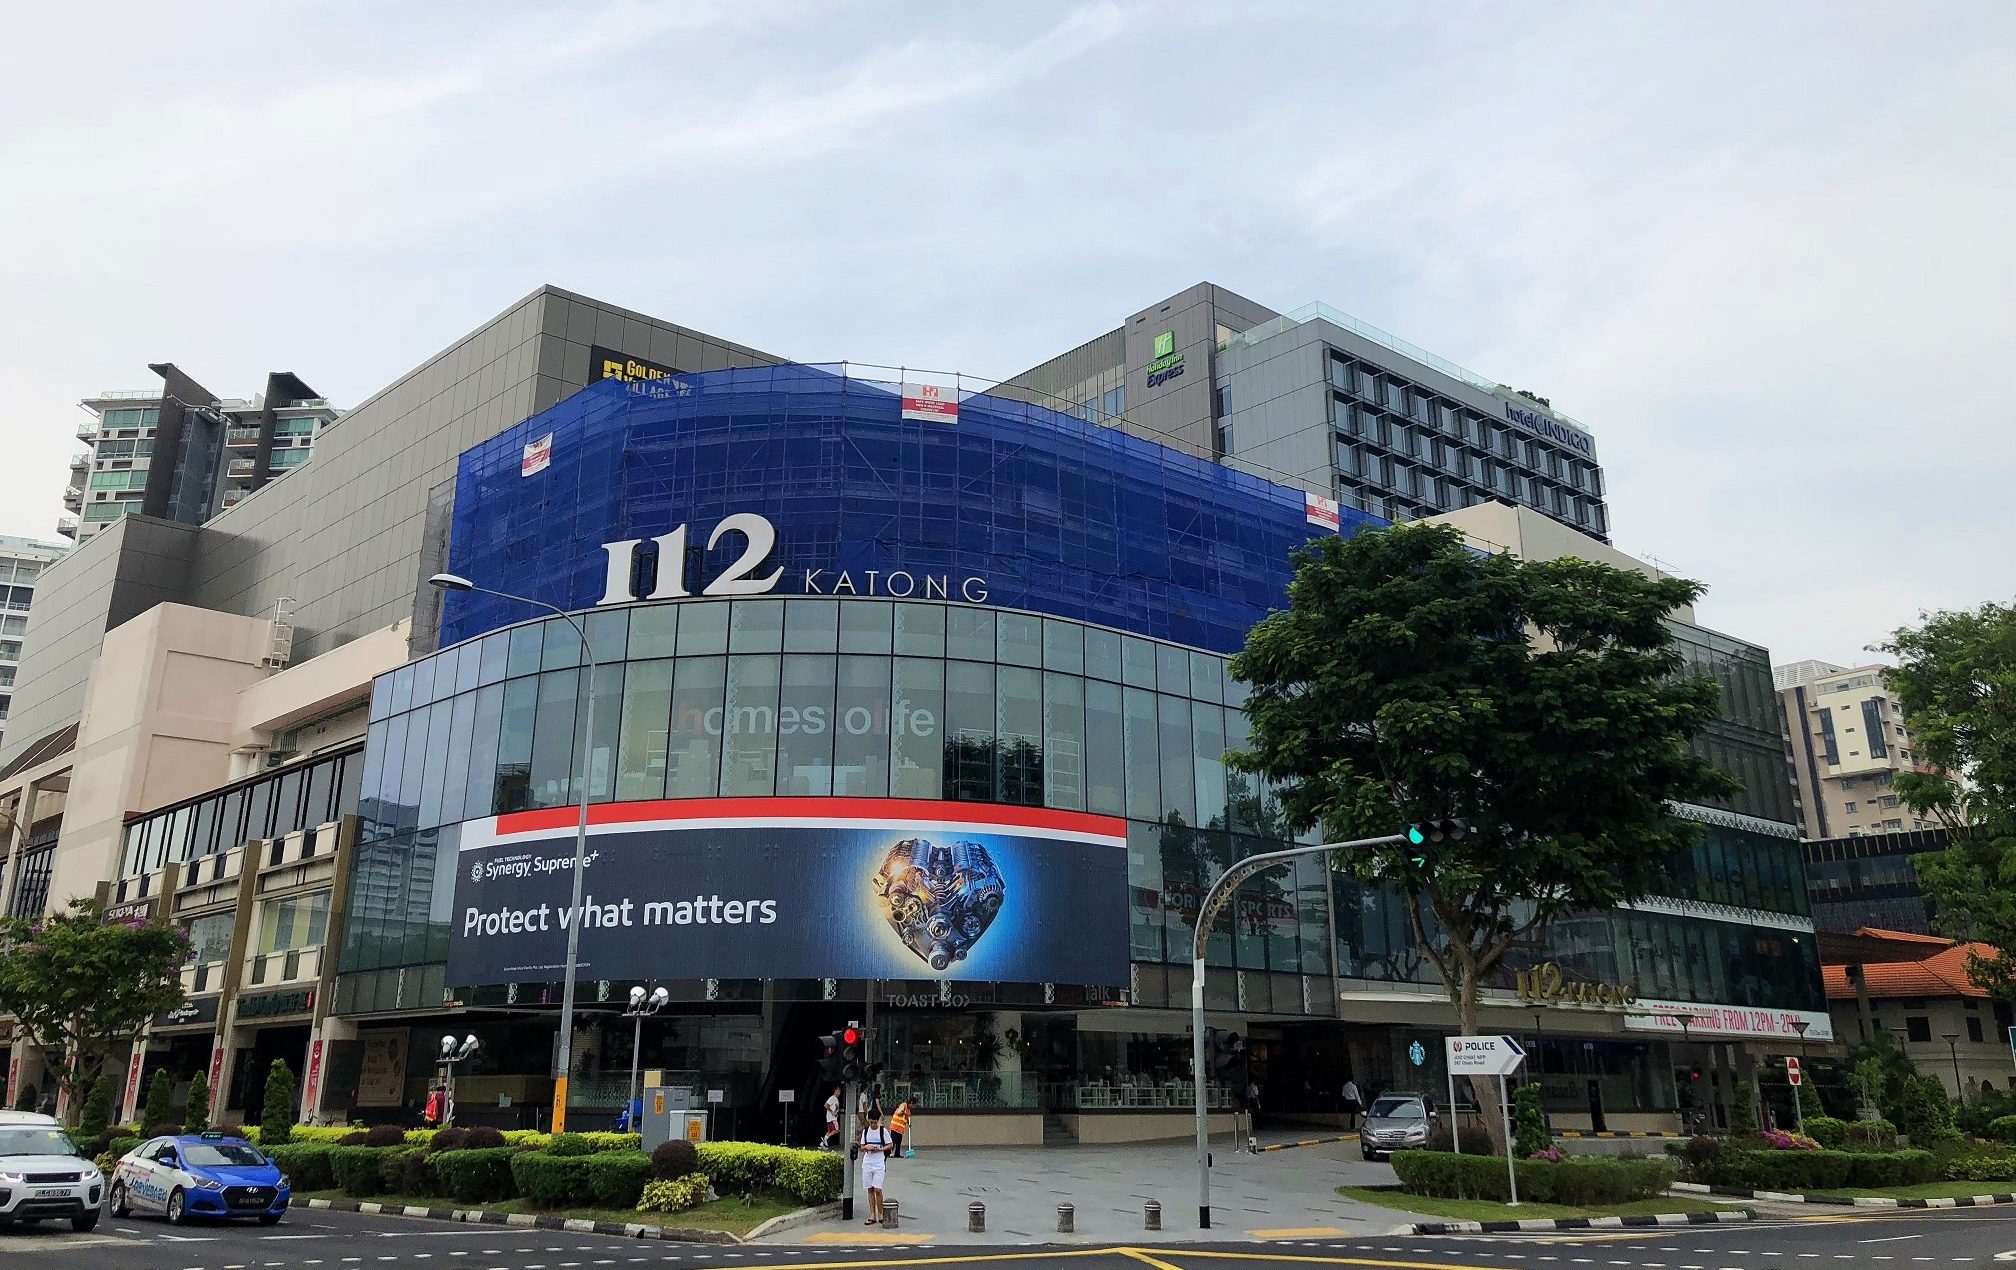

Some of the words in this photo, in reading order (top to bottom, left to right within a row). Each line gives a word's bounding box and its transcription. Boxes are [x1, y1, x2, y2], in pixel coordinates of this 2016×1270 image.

[1147, 359, 1170, 374] Holiday
[1171, 354, 1184, 364] Inn
[1147, 365, 1184, 388] Express
[1505, 402, 1533, 429] hotel
[1544, 419, 1589, 453] INDIGO
[596, 513, 784, 606] 112
[806, 568, 988, 602] KATONG
[486, 862, 531, 880] Synergy
[464, 904, 549, 937] Protect
[558, 895, 634, 929] what
[643, 895, 777, 926] matters
[887, 994, 938, 1007] TOAST
[1724, 1010, 1748, 1031] FROM
[1751, 1012, 1775, 1032] 12PM
[1465, 1042, 1495, 1051] POLICE
